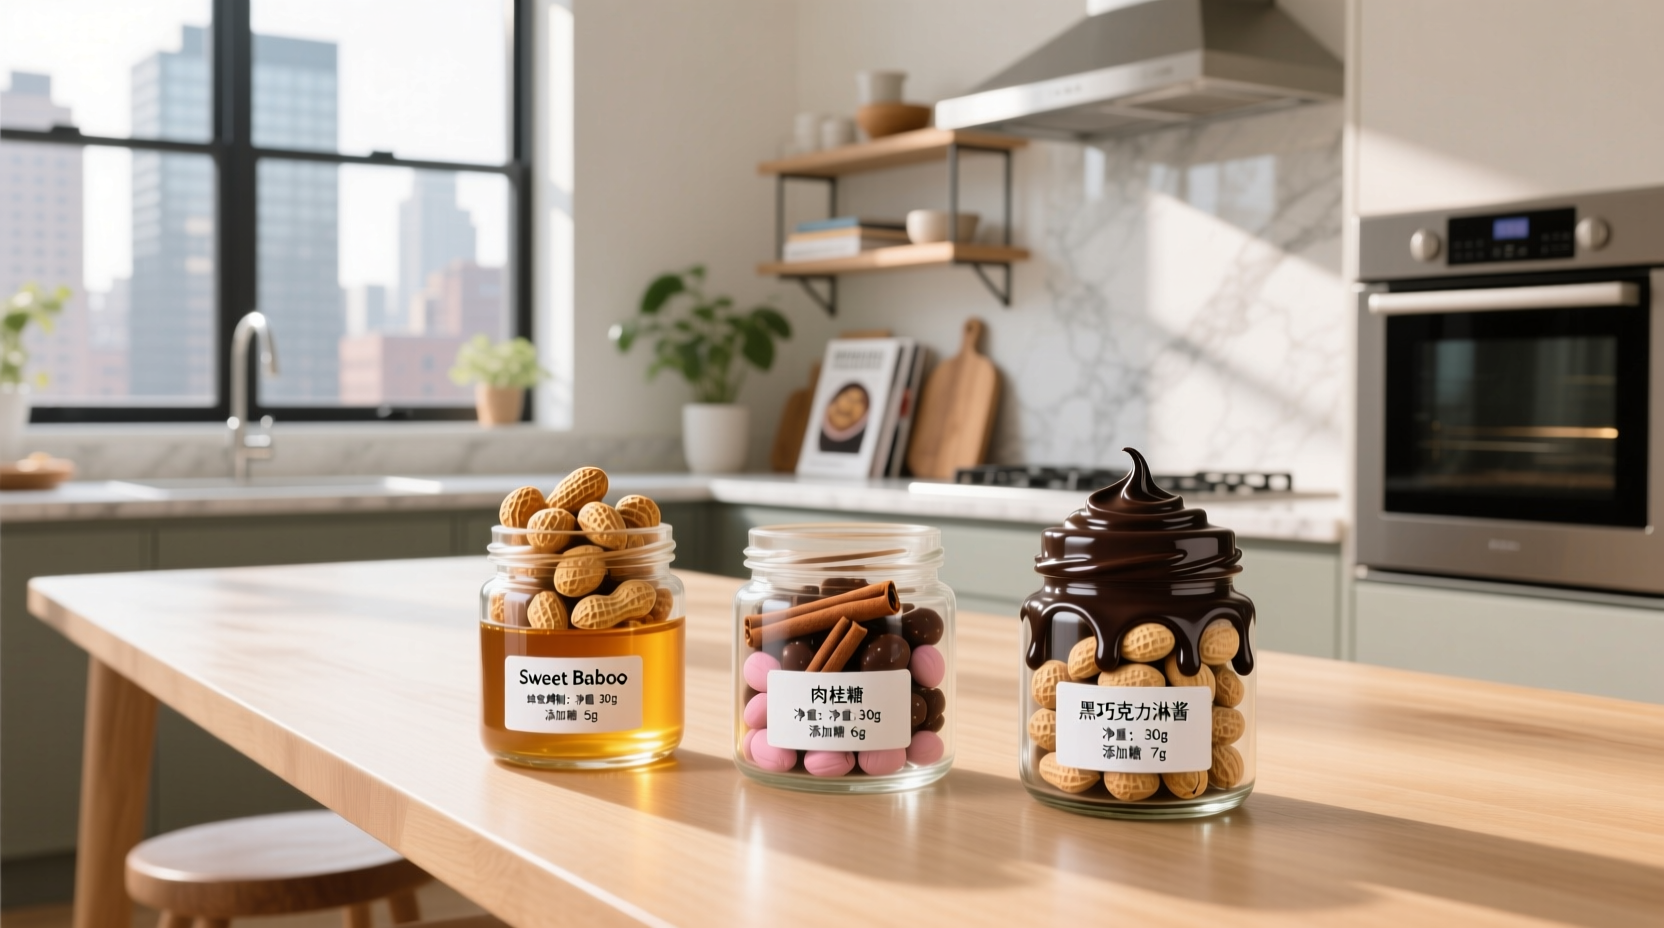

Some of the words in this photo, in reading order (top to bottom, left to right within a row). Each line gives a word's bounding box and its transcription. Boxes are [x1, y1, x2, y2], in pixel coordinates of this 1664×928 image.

[519, 669, 568, 686] Sweet
[572, 668, 628, 686] Baboo
[599, 694, 618, 706] 30g
[811, 685, 864, 705] 肉桂糖
[584, 709, 598, 723] 5g
[859, 709, 882, 723] 30g
[1079, 700, 1190, 722] 黑巧克力淋酱
[850, 726, 866, 740] 6g
[1145, 728, 1168, 743] 30g
[1150, 747, 1167, 761] 7g
